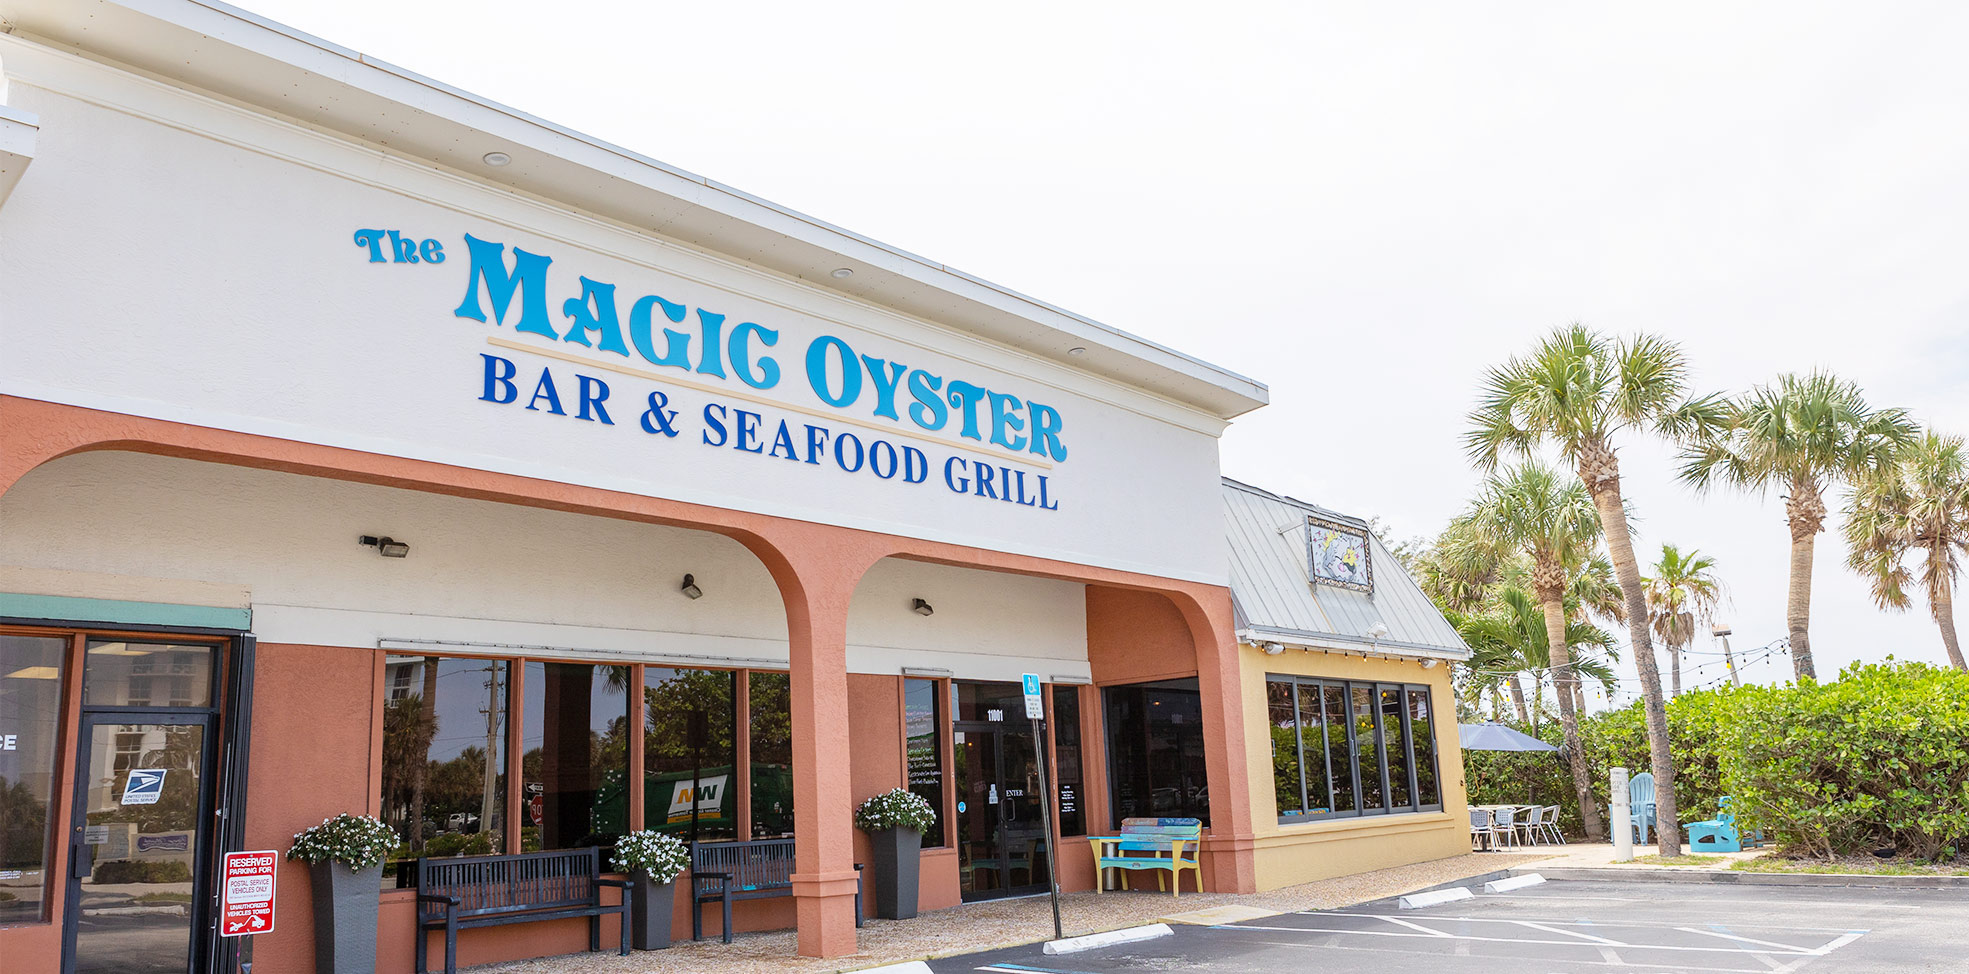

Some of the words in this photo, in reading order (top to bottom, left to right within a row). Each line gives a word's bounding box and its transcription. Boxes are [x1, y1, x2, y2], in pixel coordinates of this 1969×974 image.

[354, 229, 446, 264] The
[454, 232, 781, 390] MAGIC
[805, 335, 1068, 463] OYSTER
[478, 353, 615, 426] BAR
[640, 391, 680, 438] &
[702, 403, 928, 484] SEAFOOD
[944, 456, 1059, 511] GRILL
[0, 734, 17, 750] E
[229, 857, 273, 868] RESERVED
[250, 878, 270, 886] SERVICE
[232, 886, 254, 894] VEHICLES
[229, 902, 268, 910] UNAUTHORIZED
